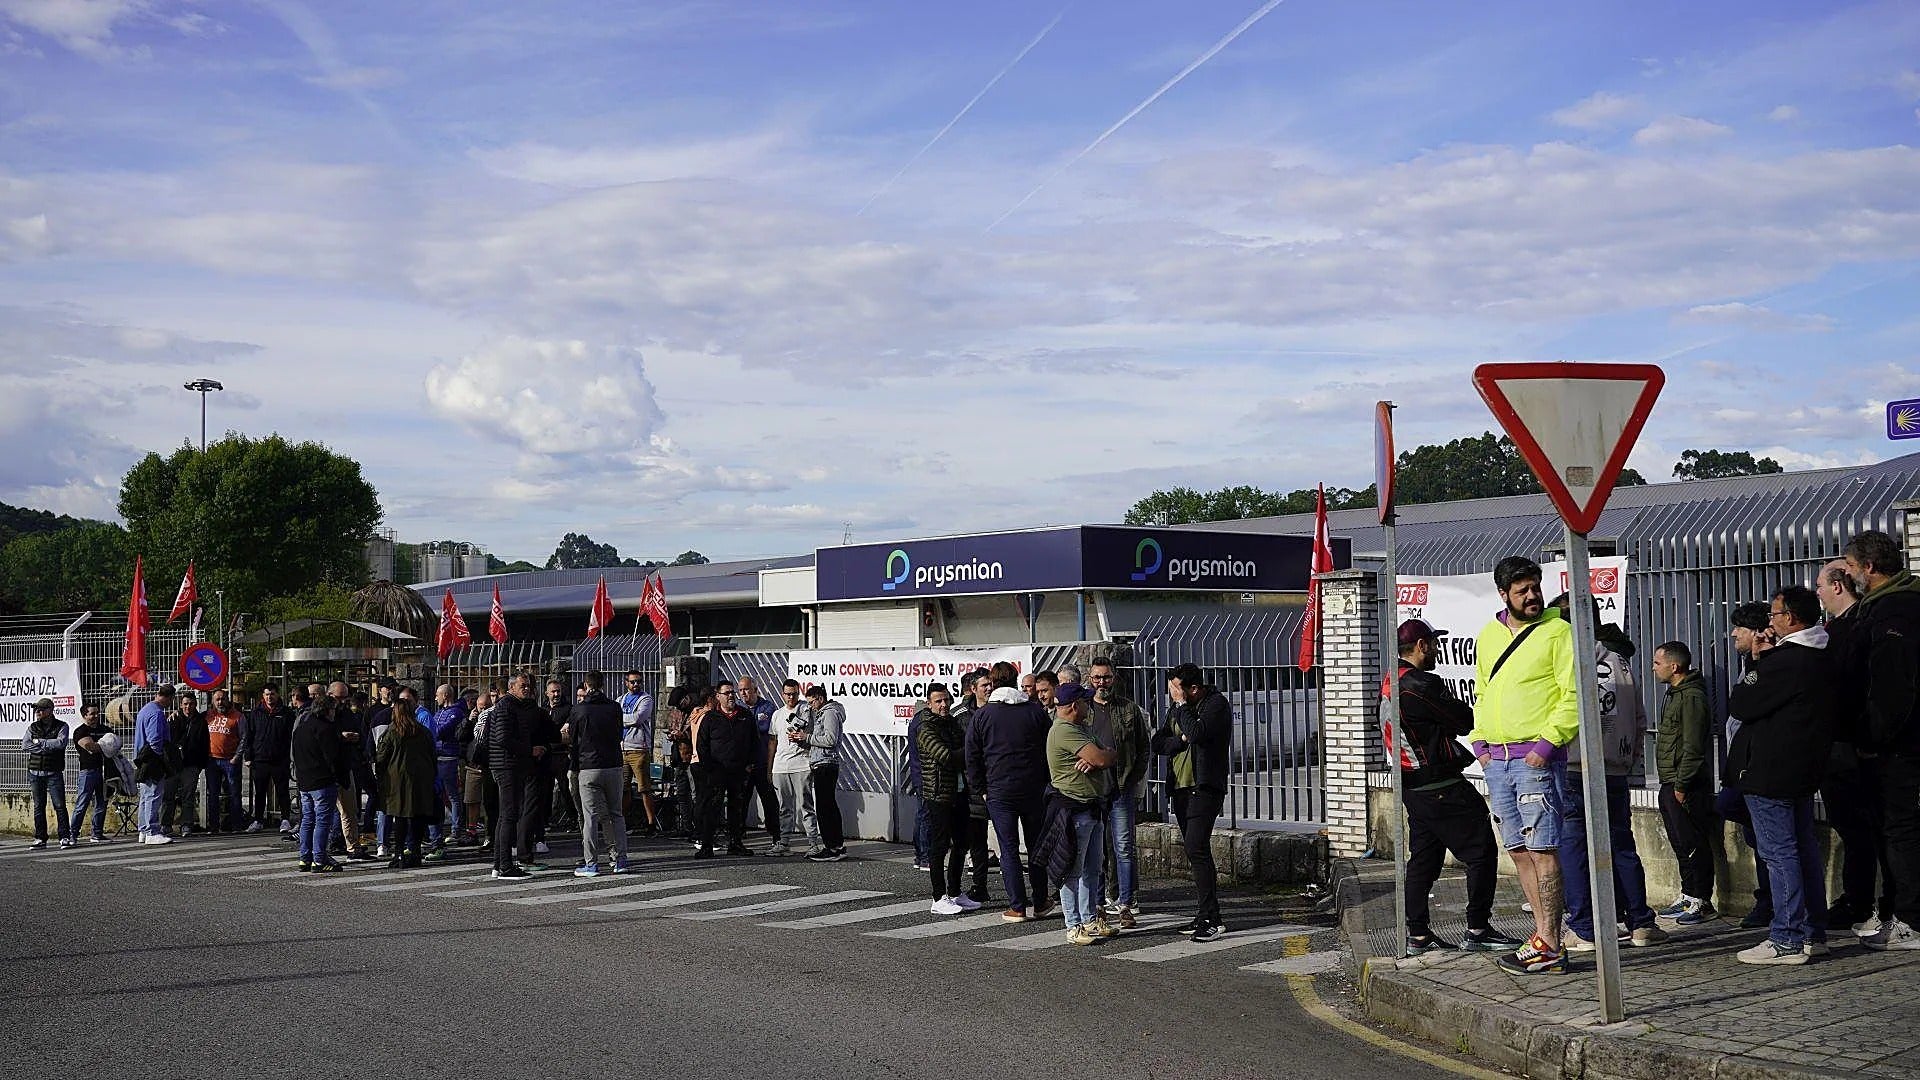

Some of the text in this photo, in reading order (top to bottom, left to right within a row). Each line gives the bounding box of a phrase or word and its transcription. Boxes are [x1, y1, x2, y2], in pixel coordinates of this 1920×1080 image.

[915, 557, 1003, 589] prysmian
[1168, 554, 1257, 582] prysmian
[1451, 637, 1477, 666] FIC
[797, 664, 818, 676] POR
[821, 664, 836, 676] UN
[839, 663, 895, 677] CONVENIO
[897, 663, 936, 677] JUSTO
[938, 663, 954, 676] EN
[0, 677, 57, 696] EFENSA DEL
[831, 682, 848, 697] LA
[850, 679, 950, 698] CONGELACI
[894, 705, 910, 717] UGT
